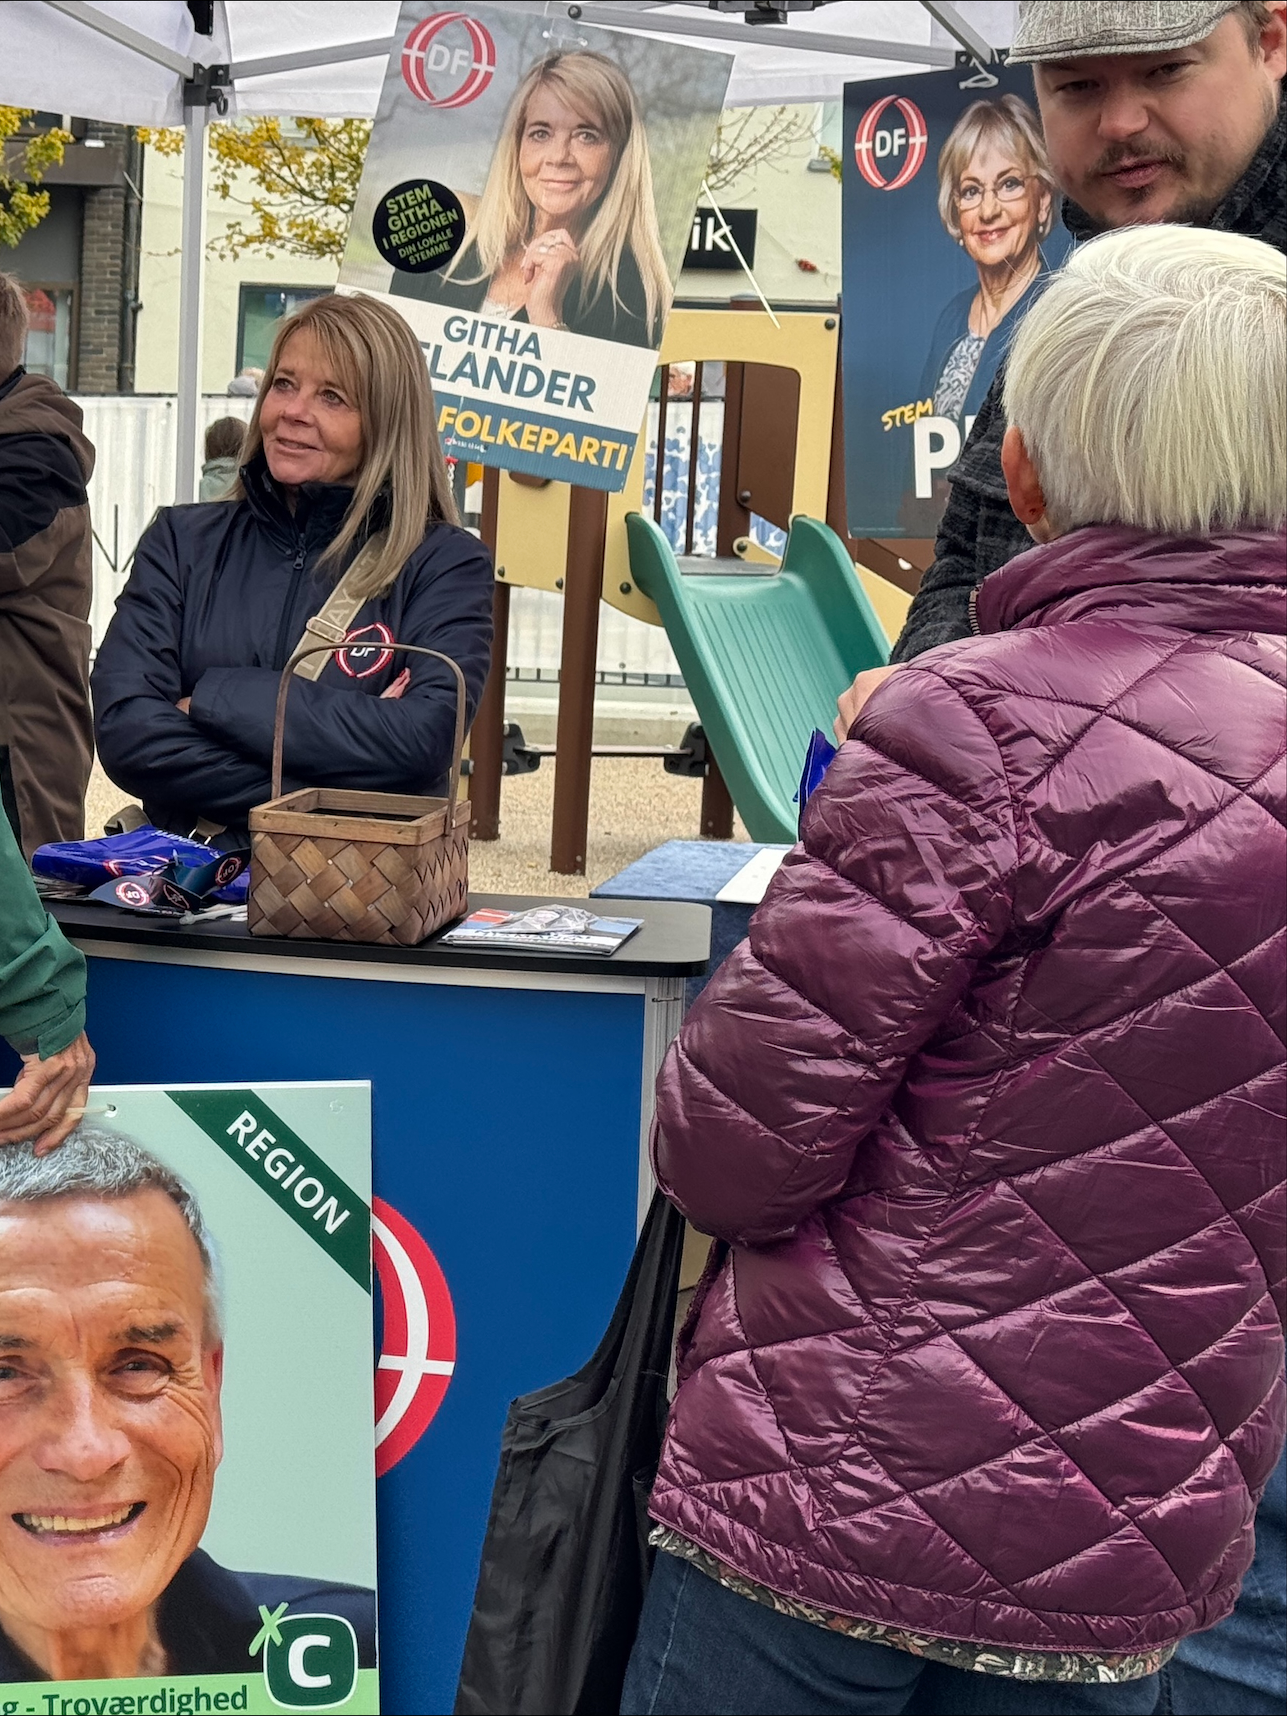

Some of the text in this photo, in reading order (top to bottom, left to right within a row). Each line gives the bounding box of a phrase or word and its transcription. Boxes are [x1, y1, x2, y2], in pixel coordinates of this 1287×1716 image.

[427, 43, 470, 75] DF
[875, 128, 906, 158] DF
[385, 183, 433, 214] STEM
[387, 198, 443, 231] GITHA
[382, 208, 459, 250] I REGIONEN
[398, 228, 454, 259] DIN LOKALE
[408, 241, 451, 265] STEMME
[443, 315, 542, 361] GITHA
[881, 398, 933, 431] STEM
[437, 405, 628, 471] FOLKEPARTI
[226, 1109, 351, 1235] REGION
[287, 1633, 332, 1688] C
[42, 1684, 248, 1715] Troværdighed
